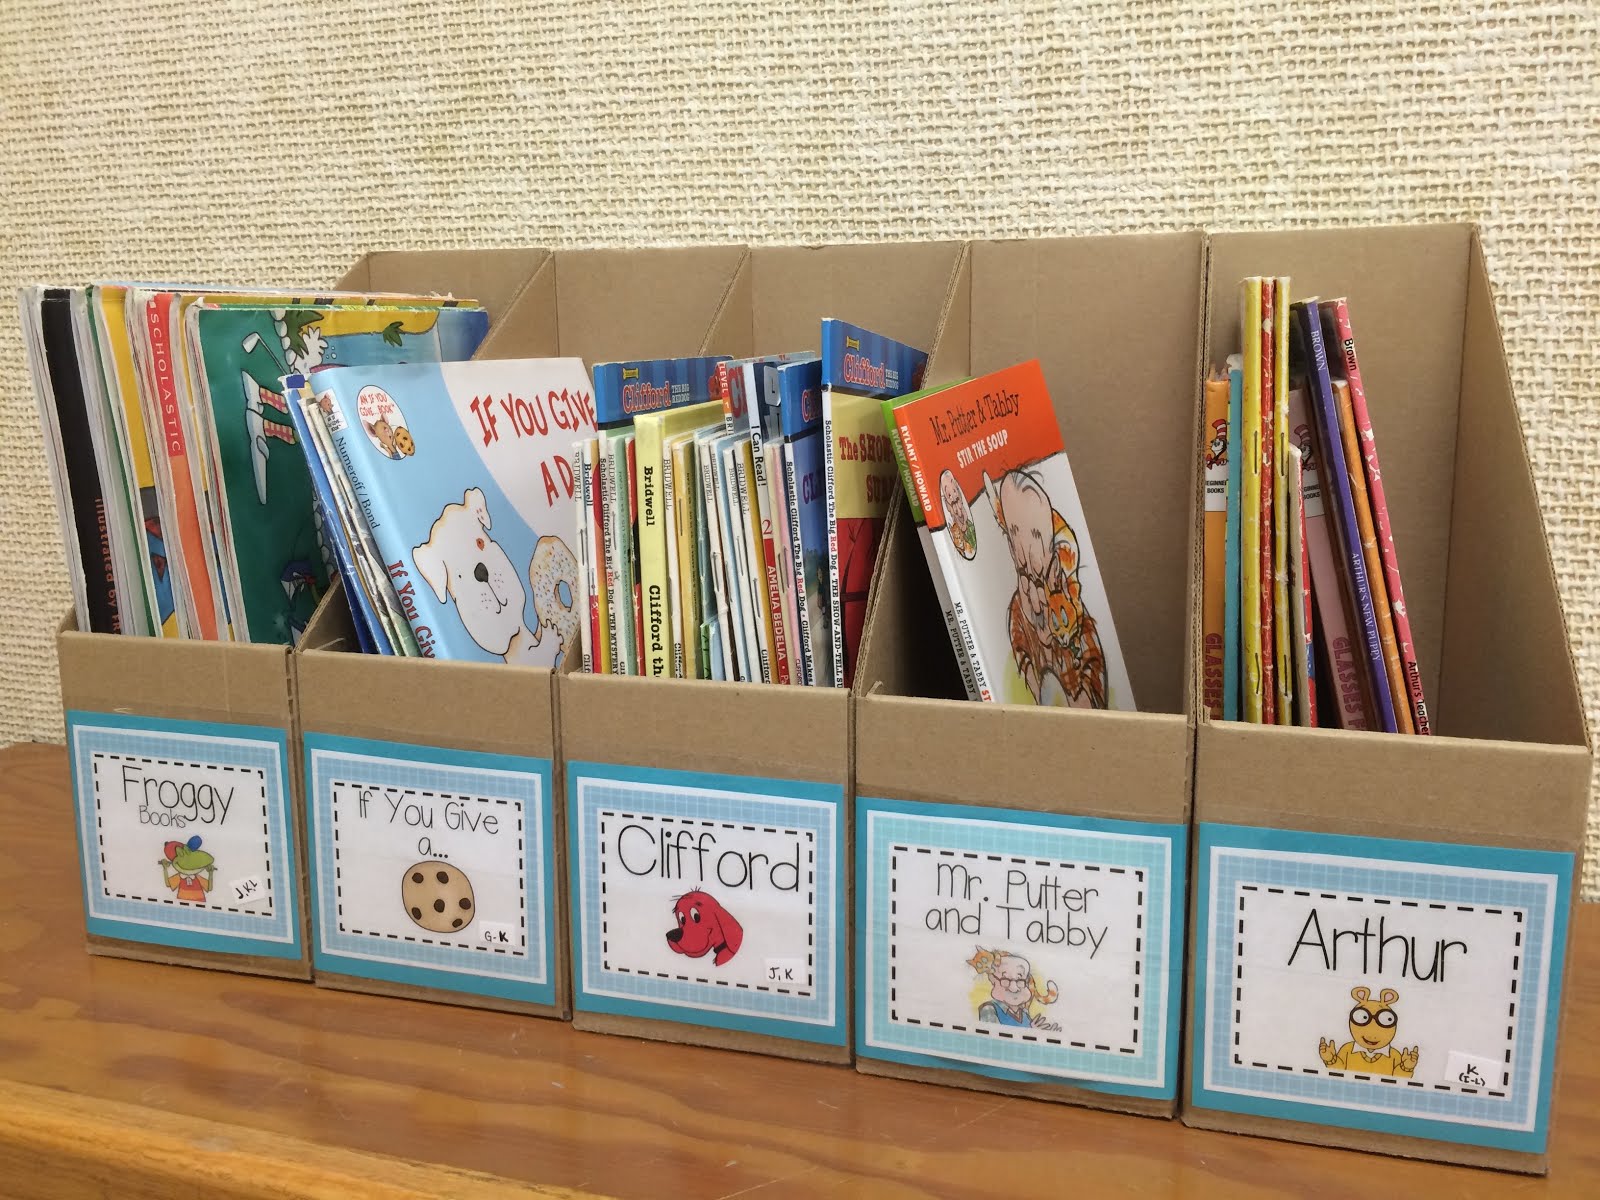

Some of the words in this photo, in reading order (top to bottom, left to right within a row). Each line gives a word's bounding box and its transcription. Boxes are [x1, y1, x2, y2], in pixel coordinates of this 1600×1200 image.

[844, 353, 886, 389] Clifford
[1310, 329, 1327, 371] BROWN
[150, 312, 182, 452] SCHOLASTIC
[623, 380, 672, 415] Clifford
[719, 365, 729, 393] LEVEL
[469, 396, 498, 448] IF
[499, 393, 549, 438] YOU
[547, 387, 598, 433] GIVE
[929, 415, 951, 446] Mr.
[947, 404, 978, 438] Putter
[975, 399, 987, 424] &
[983, 389, 1019, 421] Tabby
[752, 432, 762, 453] Can
[825, 420, 833, 464] Scholastic
[839, 436, 859, 461] The
[956, 448, 975, 469] STIR
[972, 439, 988, 461] THE
[986, 429, 1009, 453] SOUP
[336, 436, 366, 490] Numeroff
[361, 499, 381, 529] Bond
[540, 461, 560, 508] A
[553, 455, 575, 499] D
[584, 463, 594, 507] Bridwell
[600, 458, 608, 501] Scholastic
[608, 454, 617, 504] BRIDWELL
[663, 459, 673, 511] BRIDWELL
[703, 465, 713, 504] BRIDWELL
[737, 463, 750, 515] BRIDWELL
[754, 456, 767, 487] Read!
[787, 461, 796, 506] Scholastic
[827, 466, 835, 501] Clifford
[892, 428, 907, 467] RYLANT
[902, 469, 919, 507] HOWARD
[901, 425, 918, 463] RYLANT
[914, 469, 932, 512] HOWARD
[644, 466, 656, 527] Bridwell
[603, 503, 611, 537] Clifford
[762, 519, 773, 535] 2
[790, 507, 800, 542] Clifford
[1344, 337, 1357, 371] Brown
[1407, 661, 1423, 703] Arthur's
[387, 560, 409, 580] If
[398, 580, 420, 622] You
[767, 565, 783, 610] AMELIA
[1352, 552, 1369, 602] ARTHUR'S
[111, 614, 121, 633] FR
[609, 612, 617, 631] THE
[649, 585, 664, 652] Clifford
[798, 596, 807, 615] Dog
[1363, 603, 1374, 629] NEW
[610, 632, 619, 675] MYSTERY
[772, 612, 787, 661] BEDELIA
[802, 620, 812, 653] Clifford
[944, 610, 955, 626] MR.
[950, 628, 965, 659] PUTTER
[962, 668, 976, 694] TABBY
[954, 601, 964, 618] MR.
[960, 619, 975, 651] PUTTER
[973, 660, 987, 688] TABBY
[1366, 629, 1381, 661] PUPPY
[653, 657, 665, 678] th
[805, 653, 814, 684] Makes
[1204, 632, 1224, 709] GLASSES
[1332, 635, 1363, 715] GLASSES
[122, 765, 234, 826] Froggy
[138, 804, 186, 829] Books
[359, 790, 373, 819] If
[384, 791, 434, 829] You
[444, 801, 499, 835] Give
[618, 824, 800, 893] Clifford
[937, 862, 989, 902] Mr.
[1006, 869, 1099, 914] Putter
[925, 902, 982, 936] and
[996, 904, 1108, 960] Tabby
[1287, 908, 1468, 983] Arthur
[1466, 1063, 1479, 1075] K
